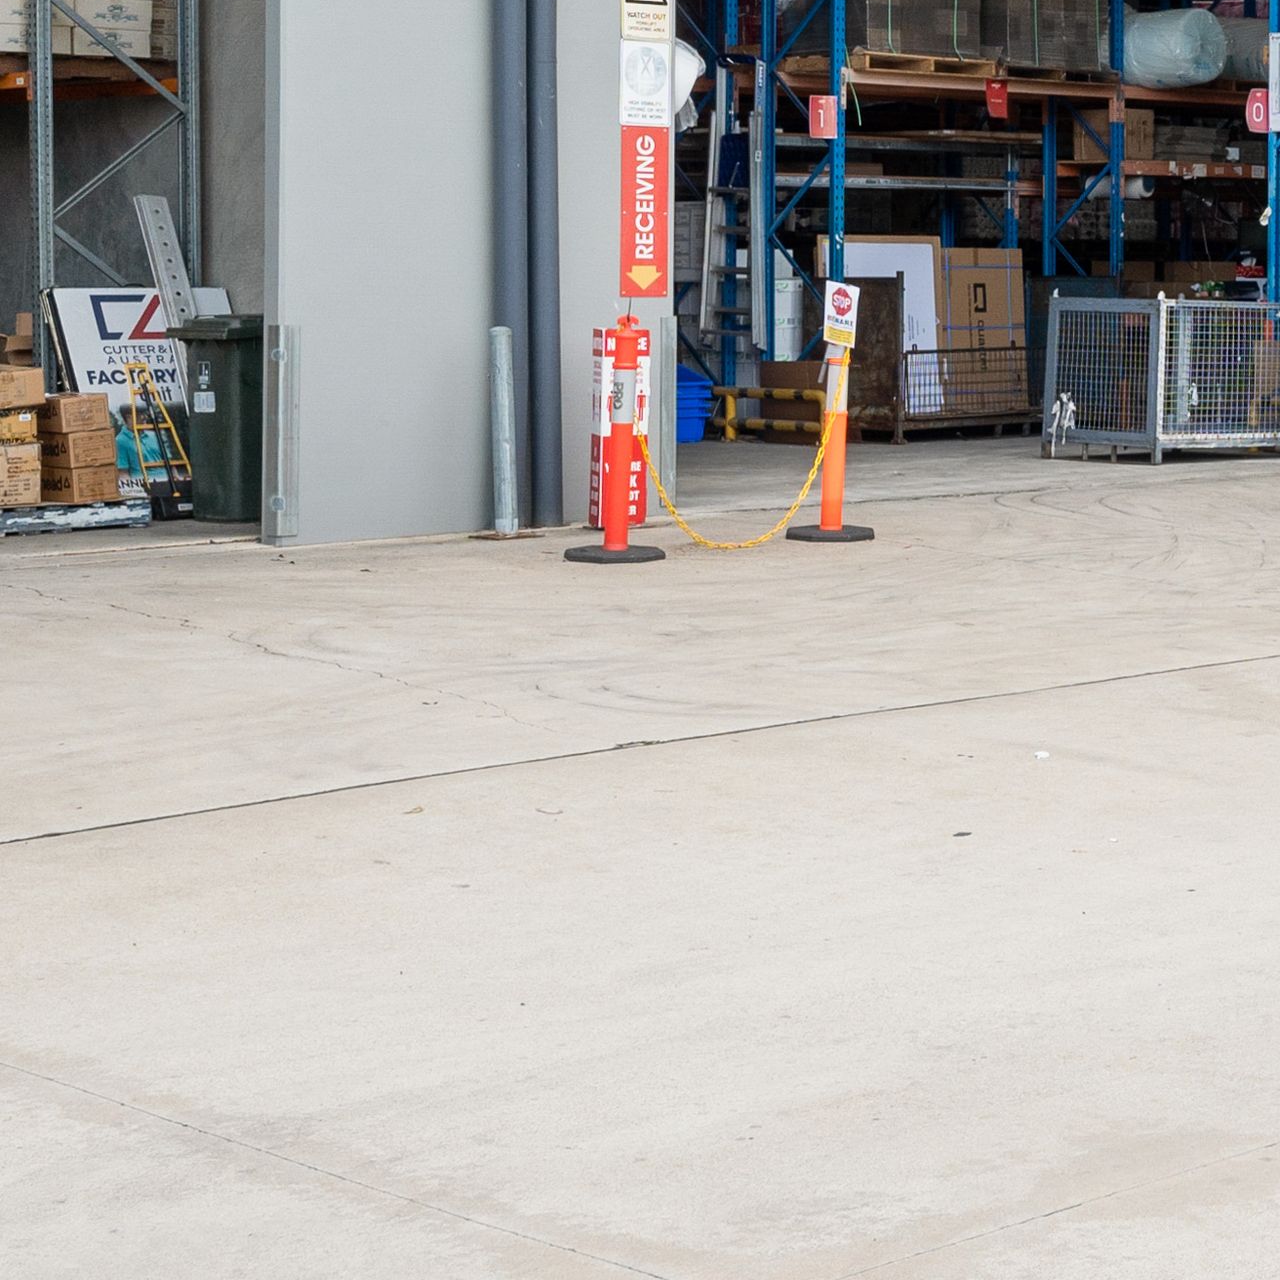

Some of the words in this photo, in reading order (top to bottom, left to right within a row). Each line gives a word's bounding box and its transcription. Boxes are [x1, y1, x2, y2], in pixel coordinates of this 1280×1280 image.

[627, 11, 650, 20] WATCH
[635, 134, 656, 260] RECEIVING
[833, 294, 851, 310] STOP
[103, 345, 155, 355] CUTTER
[158, 344, 167, 354] &
[87, 370, 177, 385] FACTORY
